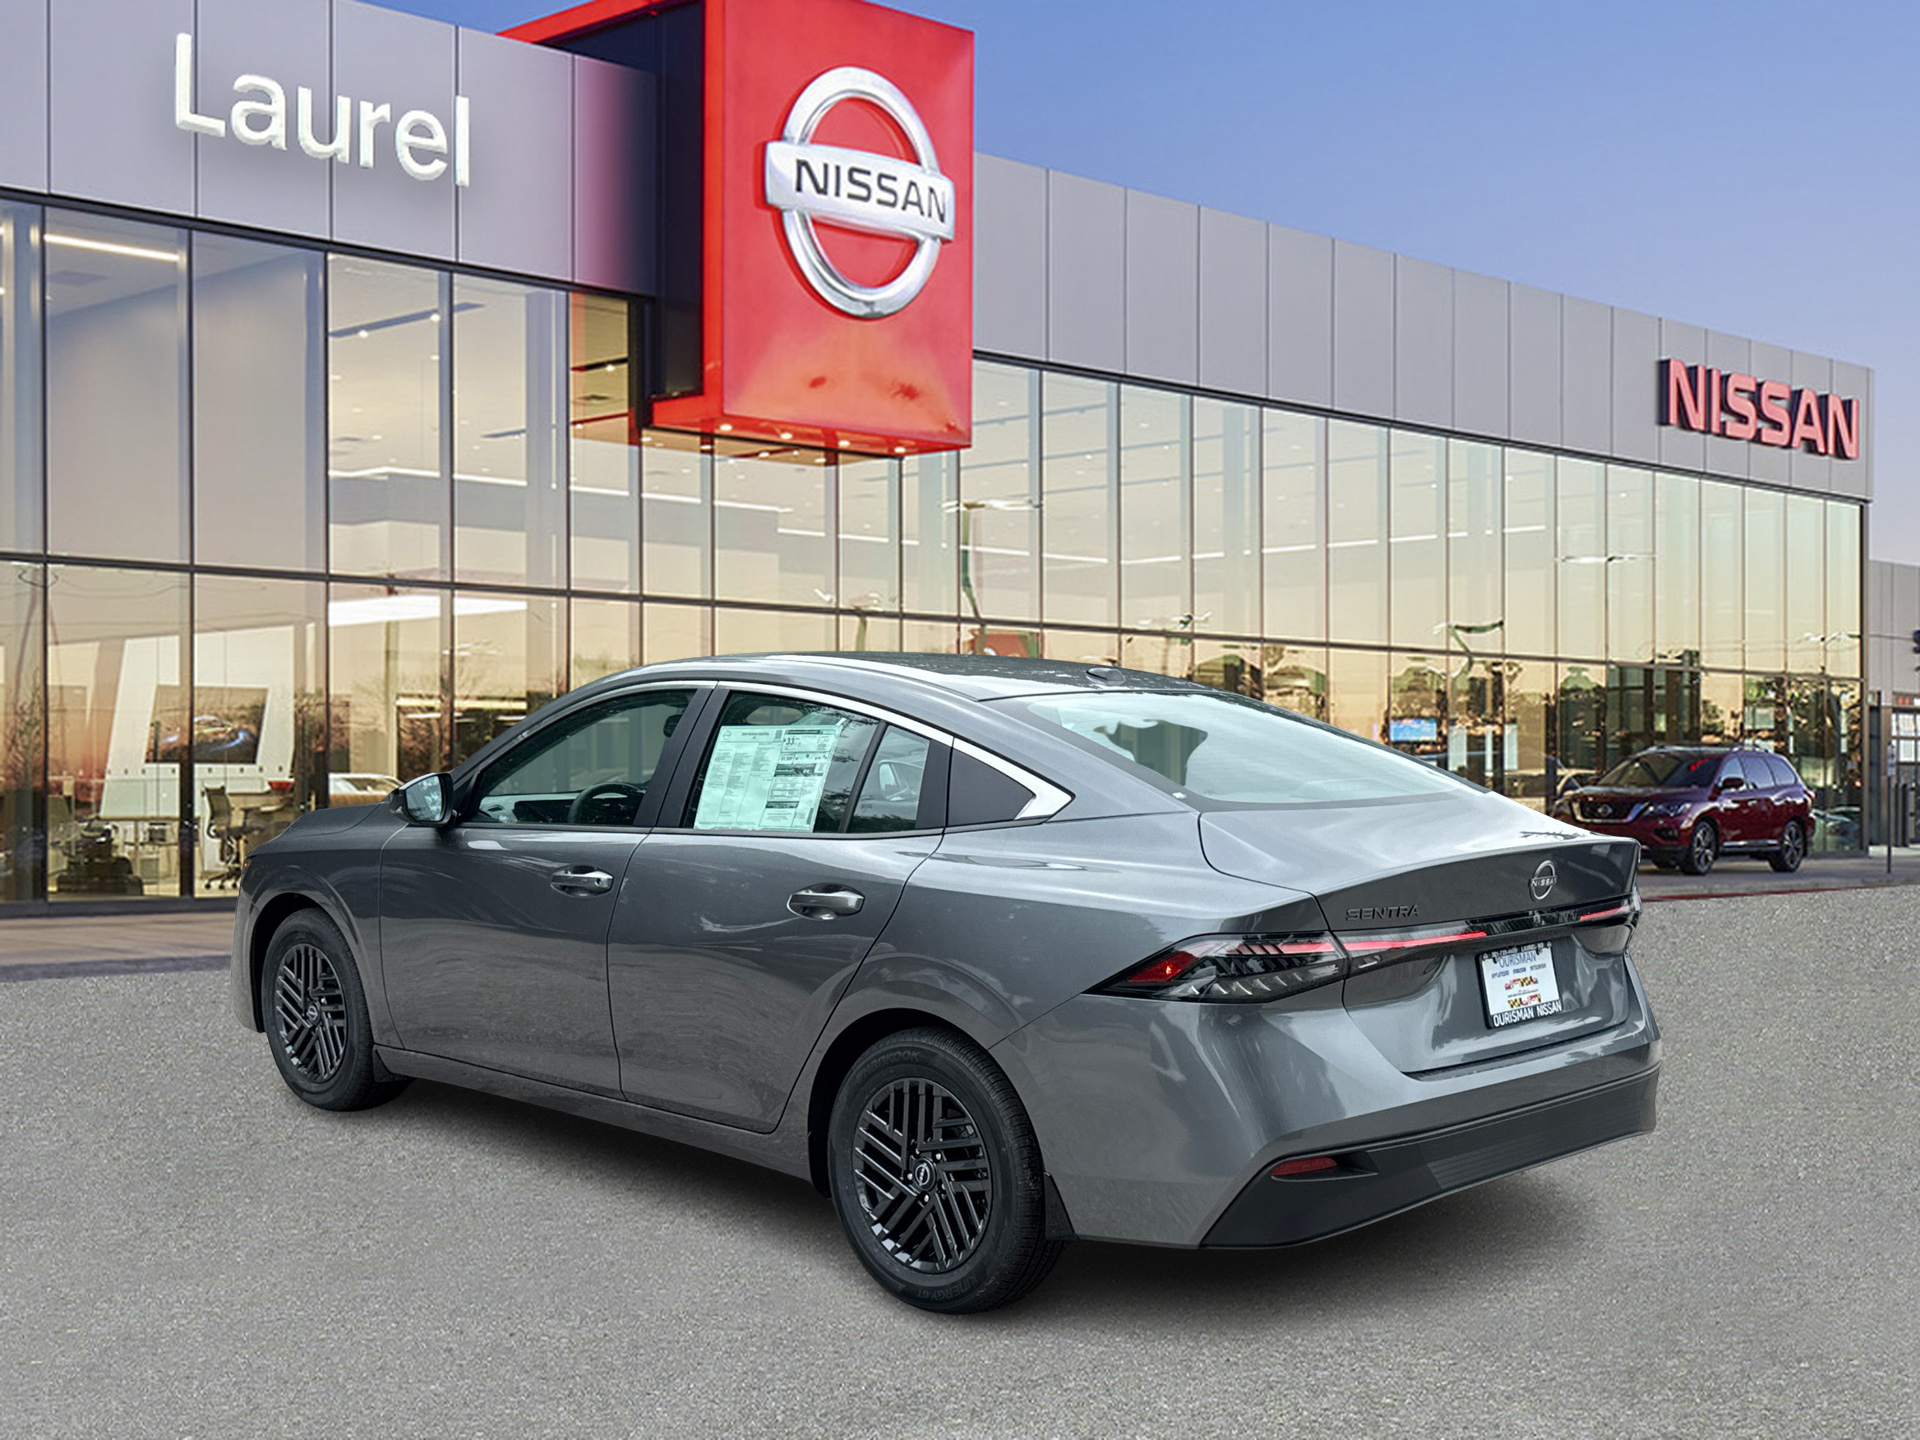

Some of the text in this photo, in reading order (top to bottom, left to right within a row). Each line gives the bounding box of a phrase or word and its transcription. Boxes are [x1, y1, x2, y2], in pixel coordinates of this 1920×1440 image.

[174, 33, 470, 187] Laurel
[795, 158, 947, 224] NISSAN
[1658, 358, 1860, 460] NISSAN
[1345, 904, 1420, 921] SENTRA
[1493, 1000, 1562, 1027] OURISMAN NISSAN
